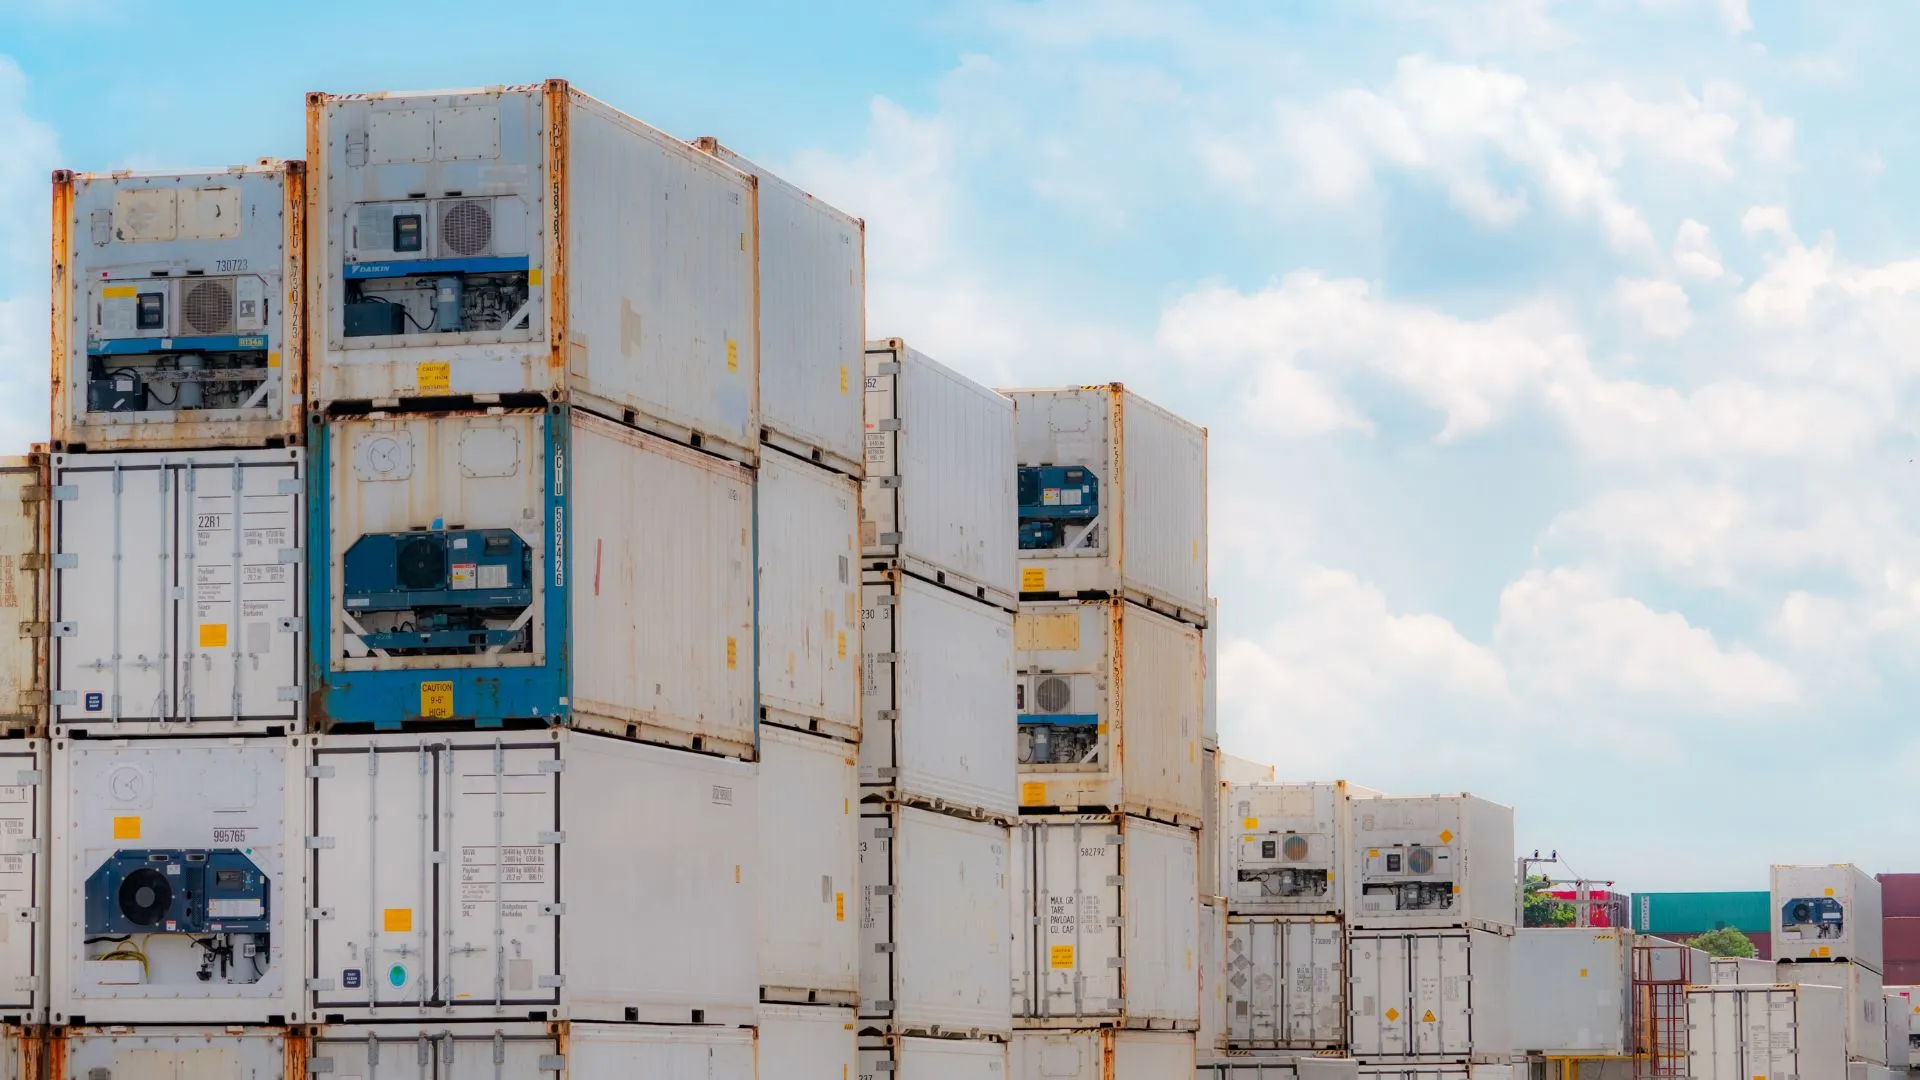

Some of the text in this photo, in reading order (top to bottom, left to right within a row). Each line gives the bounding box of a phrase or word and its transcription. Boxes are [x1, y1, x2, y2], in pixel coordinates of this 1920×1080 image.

[216, 259, 248, 272] 730723
[360, 265, 390, 273] DAIKIN
[198, 516, 220, 527] 22R1
[422, 683, 452, 691] CAUTION
[429, 708, 446, 716] HIGH
[213, 830, 246, 842] 995765
[1081, 848, 1105, 856] 582792
[1050, 896, 1073, 904] MAX GR
[1051, 906, 1064, 914] TARE
[1062, 925, 1074, 933] CAP
